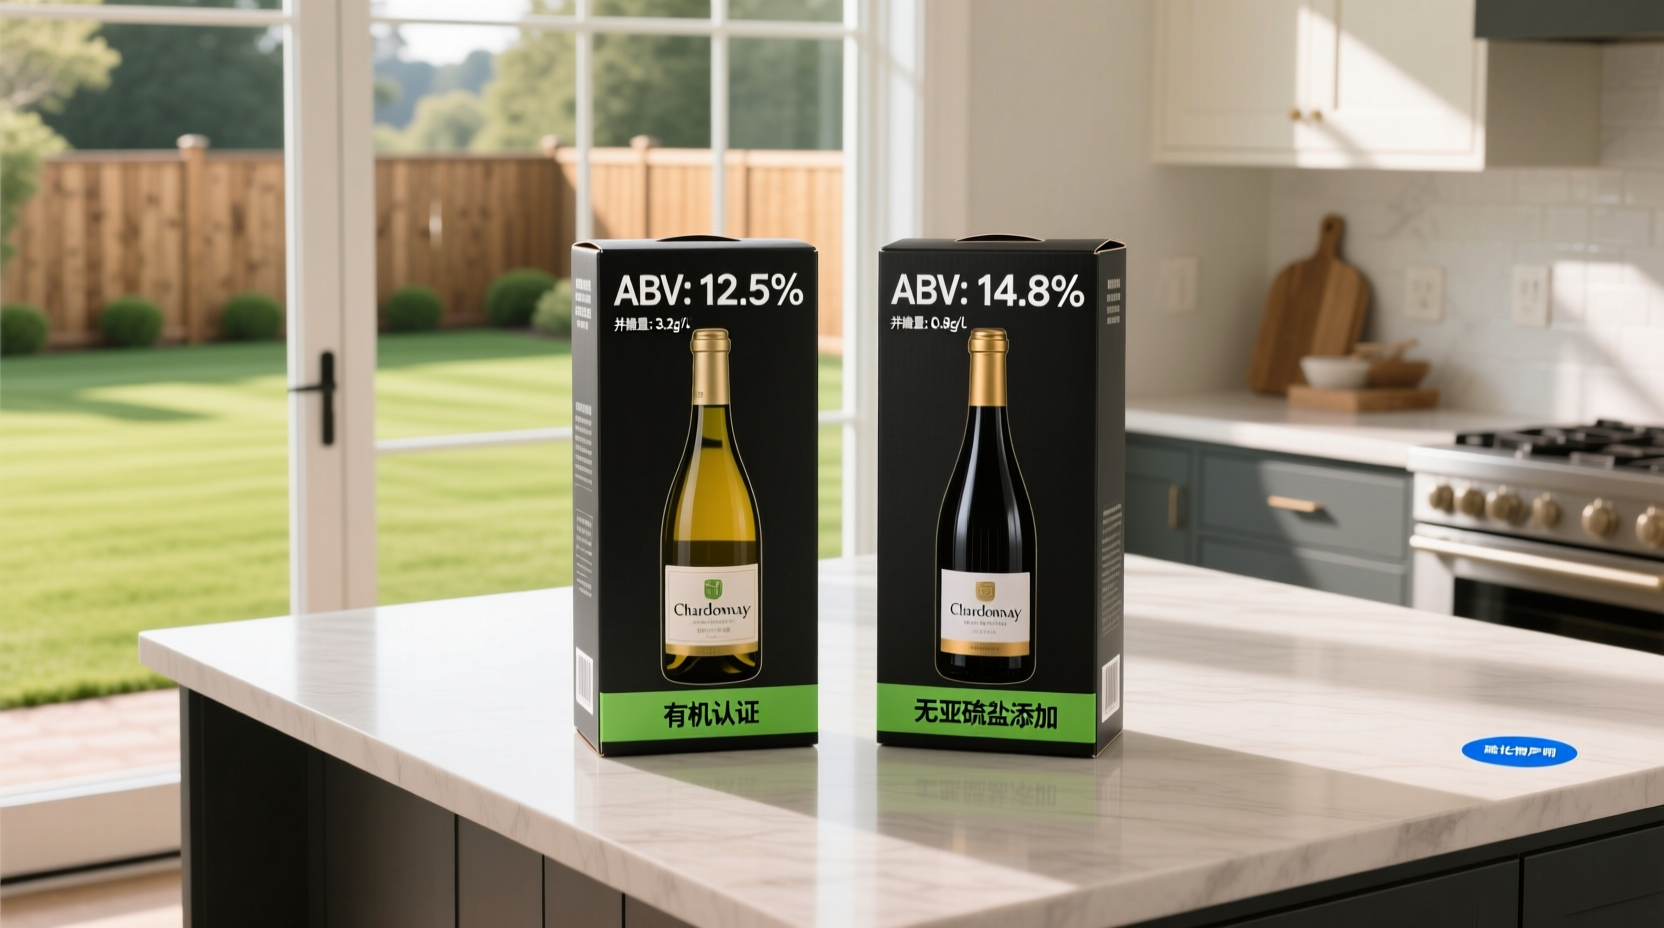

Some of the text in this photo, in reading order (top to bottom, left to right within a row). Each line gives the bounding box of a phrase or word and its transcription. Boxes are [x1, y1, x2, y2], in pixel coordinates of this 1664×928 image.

[614, 274, 691, 306] ABV:
[700, 272, 804, 306] 12.5%
[891, 273, 968, 306] ABV:
[978, 273, 1085, 307] 14.8%
[663, 700, 760, 729] 有机认证
[914, 698, 1058, 730] 无亚硫盐添加
